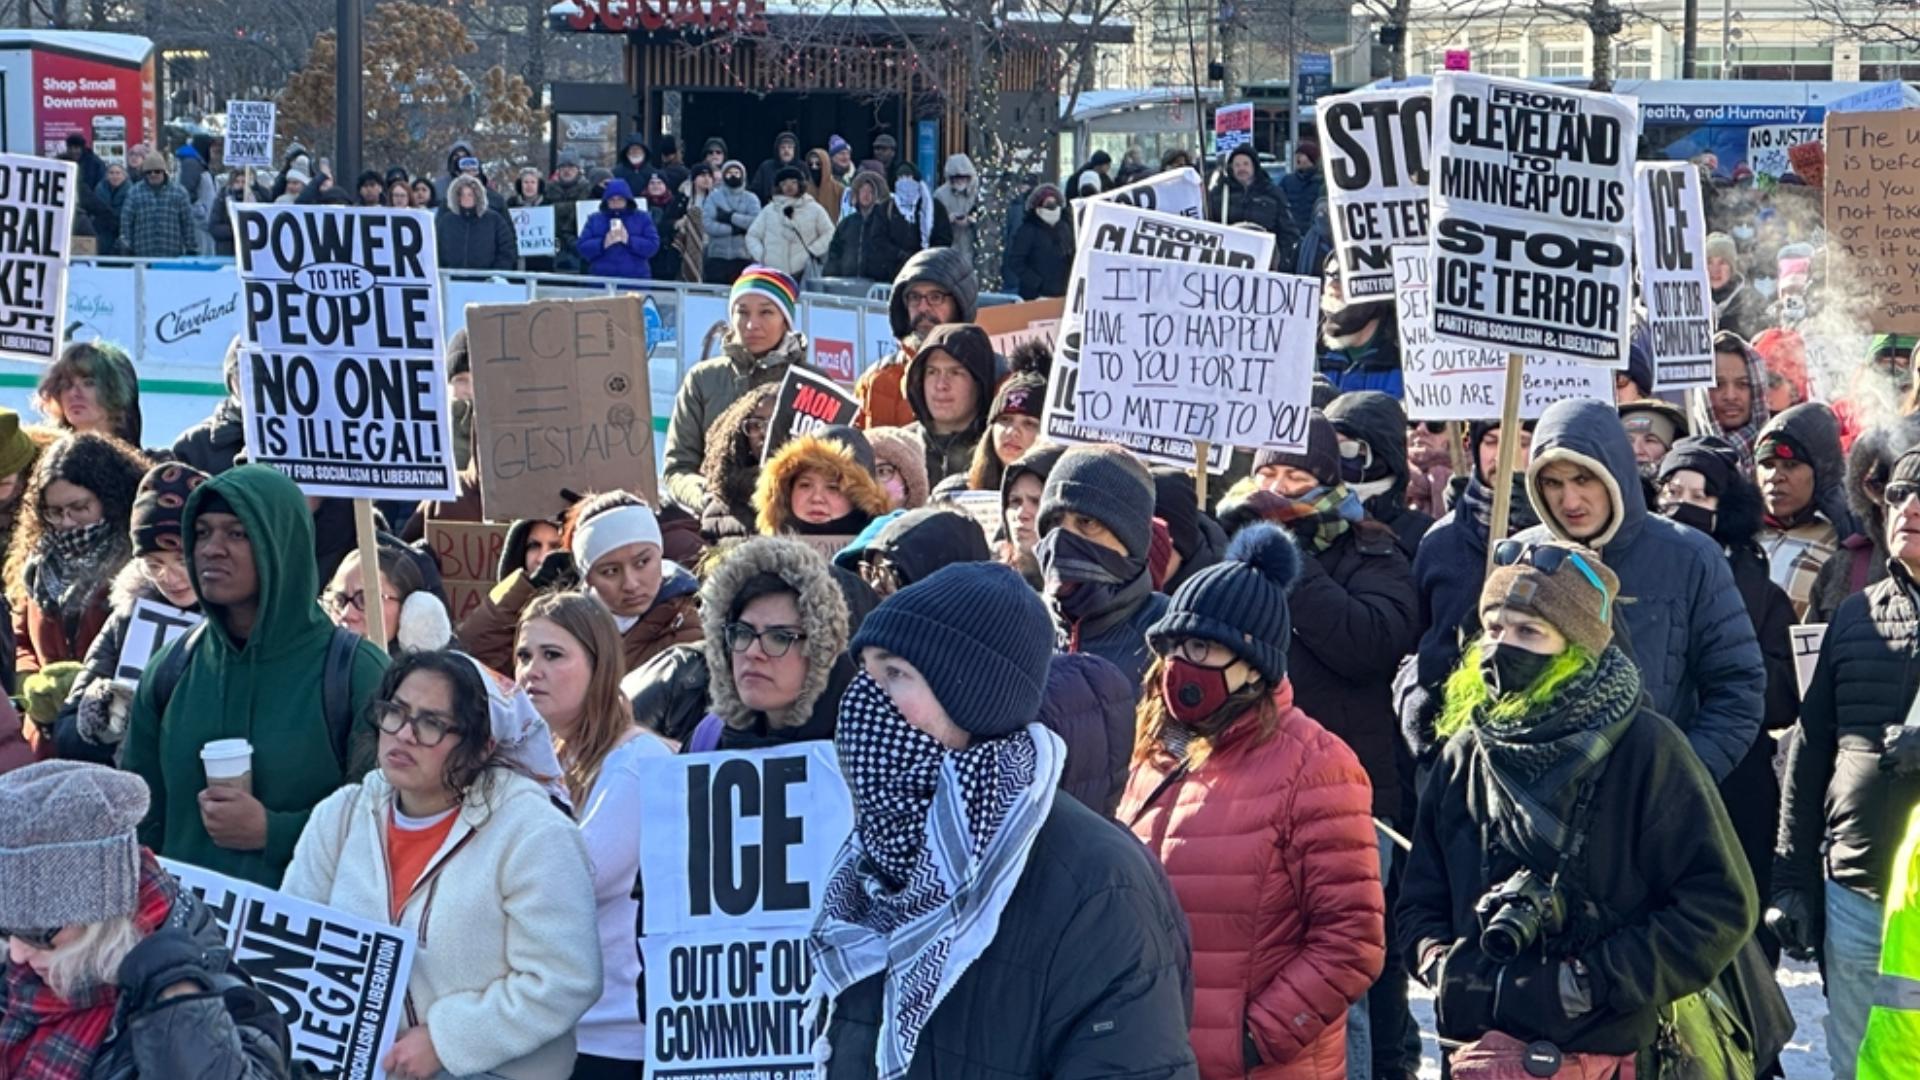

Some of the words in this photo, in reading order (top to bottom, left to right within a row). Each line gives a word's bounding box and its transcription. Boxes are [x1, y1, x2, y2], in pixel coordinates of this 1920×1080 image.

[43, 78, 76, 92] Shop
[79, 78, 116, 90] Small
[43, 95, 117, 108] Downtown
[1493, 89, 1576, 114] FROM
[1450, 94, 1621, 166] CLEVELAND
[1643, 105, 1690, 121] ealth,
[1694, 106, 1725, 120] and
[1728, 106, 1806, 123] Humanity
[1325, 96, 1431, 190] STO
[1751, 128, 1772, 148] NO
[1832, 125, 1894, 148] The
[1513, 154, 1552, 172] TO
[1843, 154, 1861, 171] is
[1869, 152, 1920, 172] befo
[17, 167, 66, 207] THE
[1441, 156, 1624, 223] MINNEAPOLIS
[1833, 178, 1870, 198] And
[0, 205, 60, 258] RAL
[1336, 202, 1382, 242] ICE
[1383, 199, 1430, 239] TER
[1648, 169, 1693, 271] ICE
[1838, 204, 1876, 221] not
[1840, 226, 1864, 240] or
[238, 210, 427, 279] POWER
[1140, 220, 1219, 249] FROM
[1437, 217, 1625, 274] STOP
[0, 259, 47, 309] KE!
[307, 270, 328, 290] TO
[331, 270, 361, 290] THE
[1102, 268, 1162, 303] IT
[1436, 257, 1486, 311] ICE
[1493, 266, 1620, 333] TERROR
[1653, 281, 1671, 318] OUT
[1672, 281, 1683, 316] OF
[1684, 281, 1703, 317] OUR
[0, 311, 55, 333] UT!
[155, 292, 238, 344] Cleveland
[245, 282, 434, 349] PEOPLE
[484, 305, 610, 364] ICE
[1084, 310, 1126, 346] HAVE
[1139, 313, 1174, 347] TO
[1185, 315, 1285, 353] HAPPEN
[1437, 313, 1467, 332] PARTY
[1468, 319, 1489, 337] FOR
[1489, 322, 1543, 346] SOCIALISM
[1544, 330, 1558, 348] &
[1559, 333, 1617, 356] LIBERATION
[1652, 319, 1712, 357] COMMUNITIES
[816, 351, 839, 370] CIRCLE
[1091, 351, 1123, 382] TO
[1133, 349, 1179, 383] YOU
[1190, 355, 1236, 390] FOR
[1238, 357, 1275, 395] IT
[1403, 348, 1425, 372] AS
[1432, 348, 1506, 371] OUTRAGE
[250, 353, 320, 416] NO
[334, 357, 437, 421] ONE
[1405, 384, 1452, 408] WHO
[1460, 382, 1496, 406] ARE
[1522, 373, 1591, 392] Benjamin
[1078, 391, 1112, 421] TO
[1122, 395, 1220, 438] MATTER
[1226, 401, 1257, 438] TO
[1268, 400, 1309, 443] YOU
[256, 416, 288, 456] IS
[298, 418, 443, 464] ILLEGAL!
[492, 420, 651, 480] GESTAPO
[294, 464, 315, 479] FOR
[316, 466, 370, 483] SOCIALISM
[381, 471, 444, 486] LIBERATION
[436, 530, 503, 580] BUR
[687, 755, 810, 916] ICE
[371, 938, 398, 1011] LIBERATION
[669, 944, 723, 1002] OUT
[728, 941, 767, 998] OF
[771, 939, 810, 996] OU
[295, 920, 373, 1078] LEGAL!
[655, 999, 812, 1063] COMMUNIT
